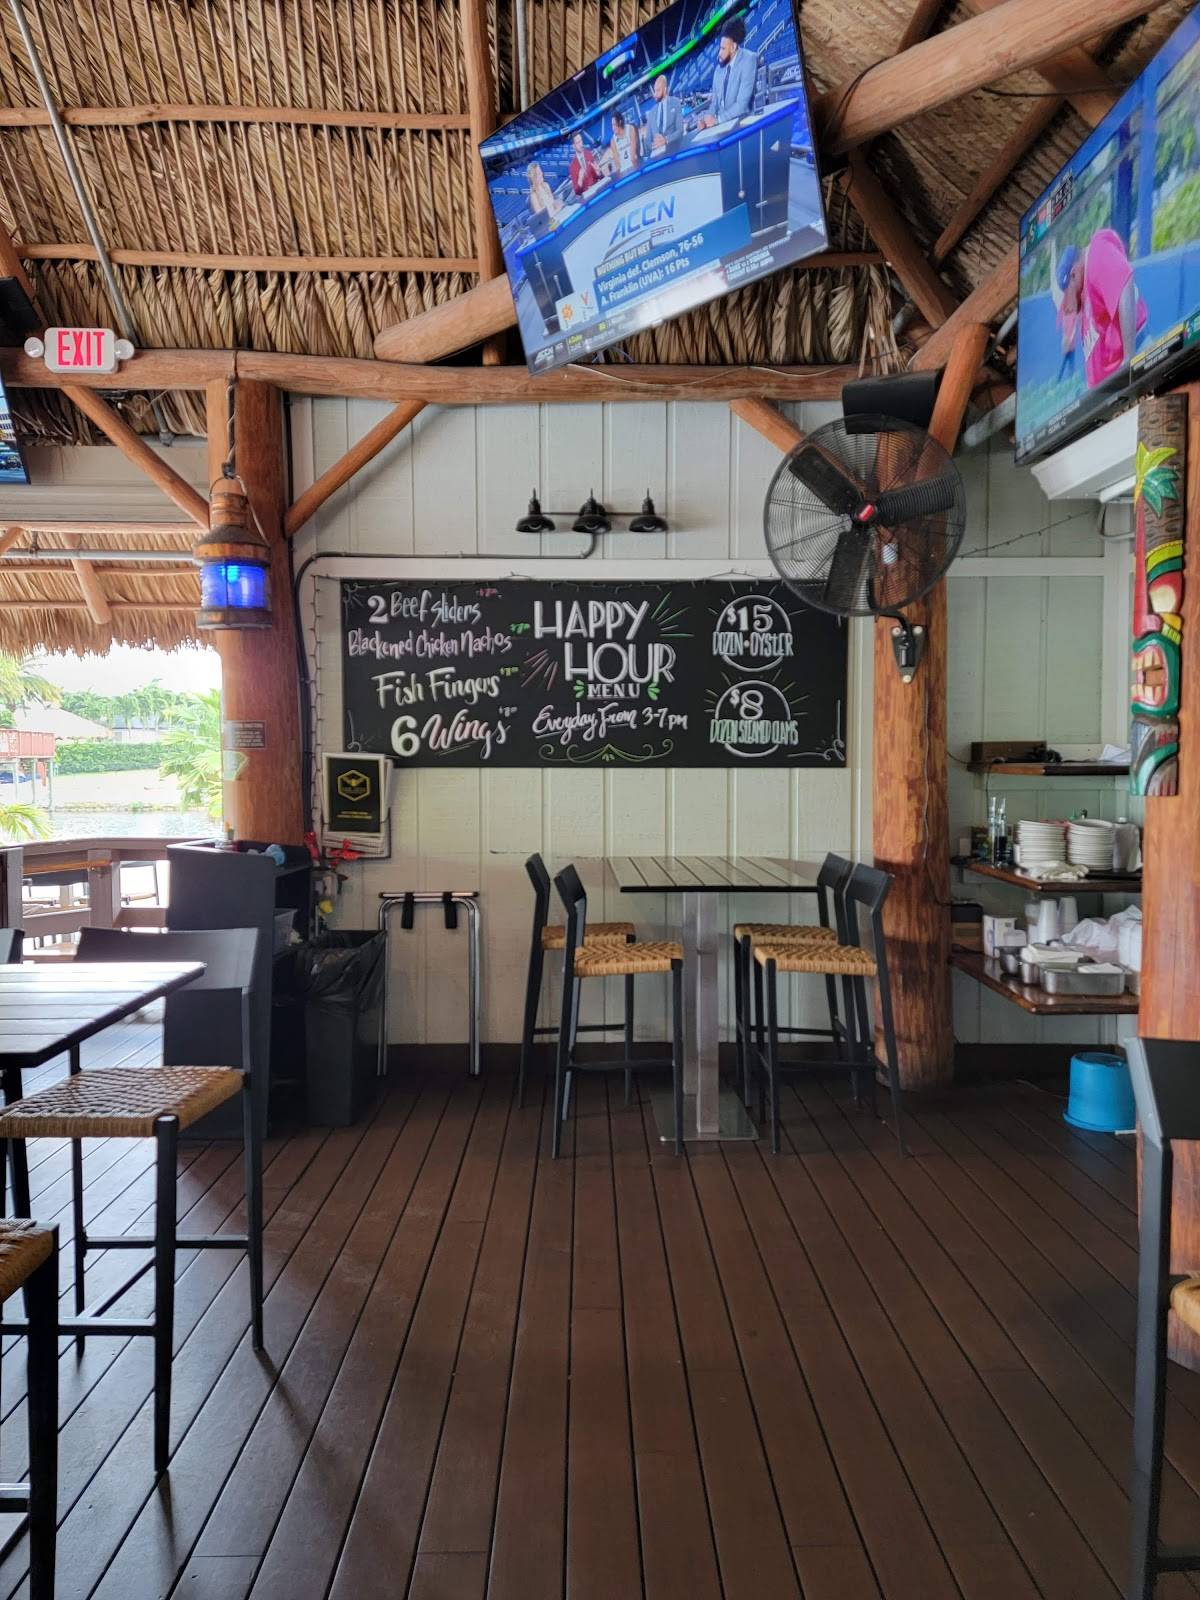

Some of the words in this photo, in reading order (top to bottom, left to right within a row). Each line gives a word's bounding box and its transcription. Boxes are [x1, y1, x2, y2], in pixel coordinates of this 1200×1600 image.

[609, 195, 676, 246] ACCN
[597, 272, 627, 292] Virginia
[678, 232, 704, 254] 76-56
[609, 281, 639, 302] Franklin
[664, 262, 675, 275] 16
[57, 331, 105, 366] EXIT
[367, 594, 389, 624] 2
[390, 589, 432, 622] Beef
[534, 600, 650, 640] HAPPY
[726, 604, 774, 633] $15
[348, 627, 414, 660] Blackened
[415, 629, 459, 659] Chicken
[564, 642, 676, 683] HOUR
[371, 670, 424, 709] Fish
[425, 666, 500, 705] Fingers
[587, 683, 641, 698] MENU
[729, 688, 764, 721] $8
[390, 714, 420, 757] 6
[532, 701, 598, 745] Everyday
[597, 702, 637, 738] From
